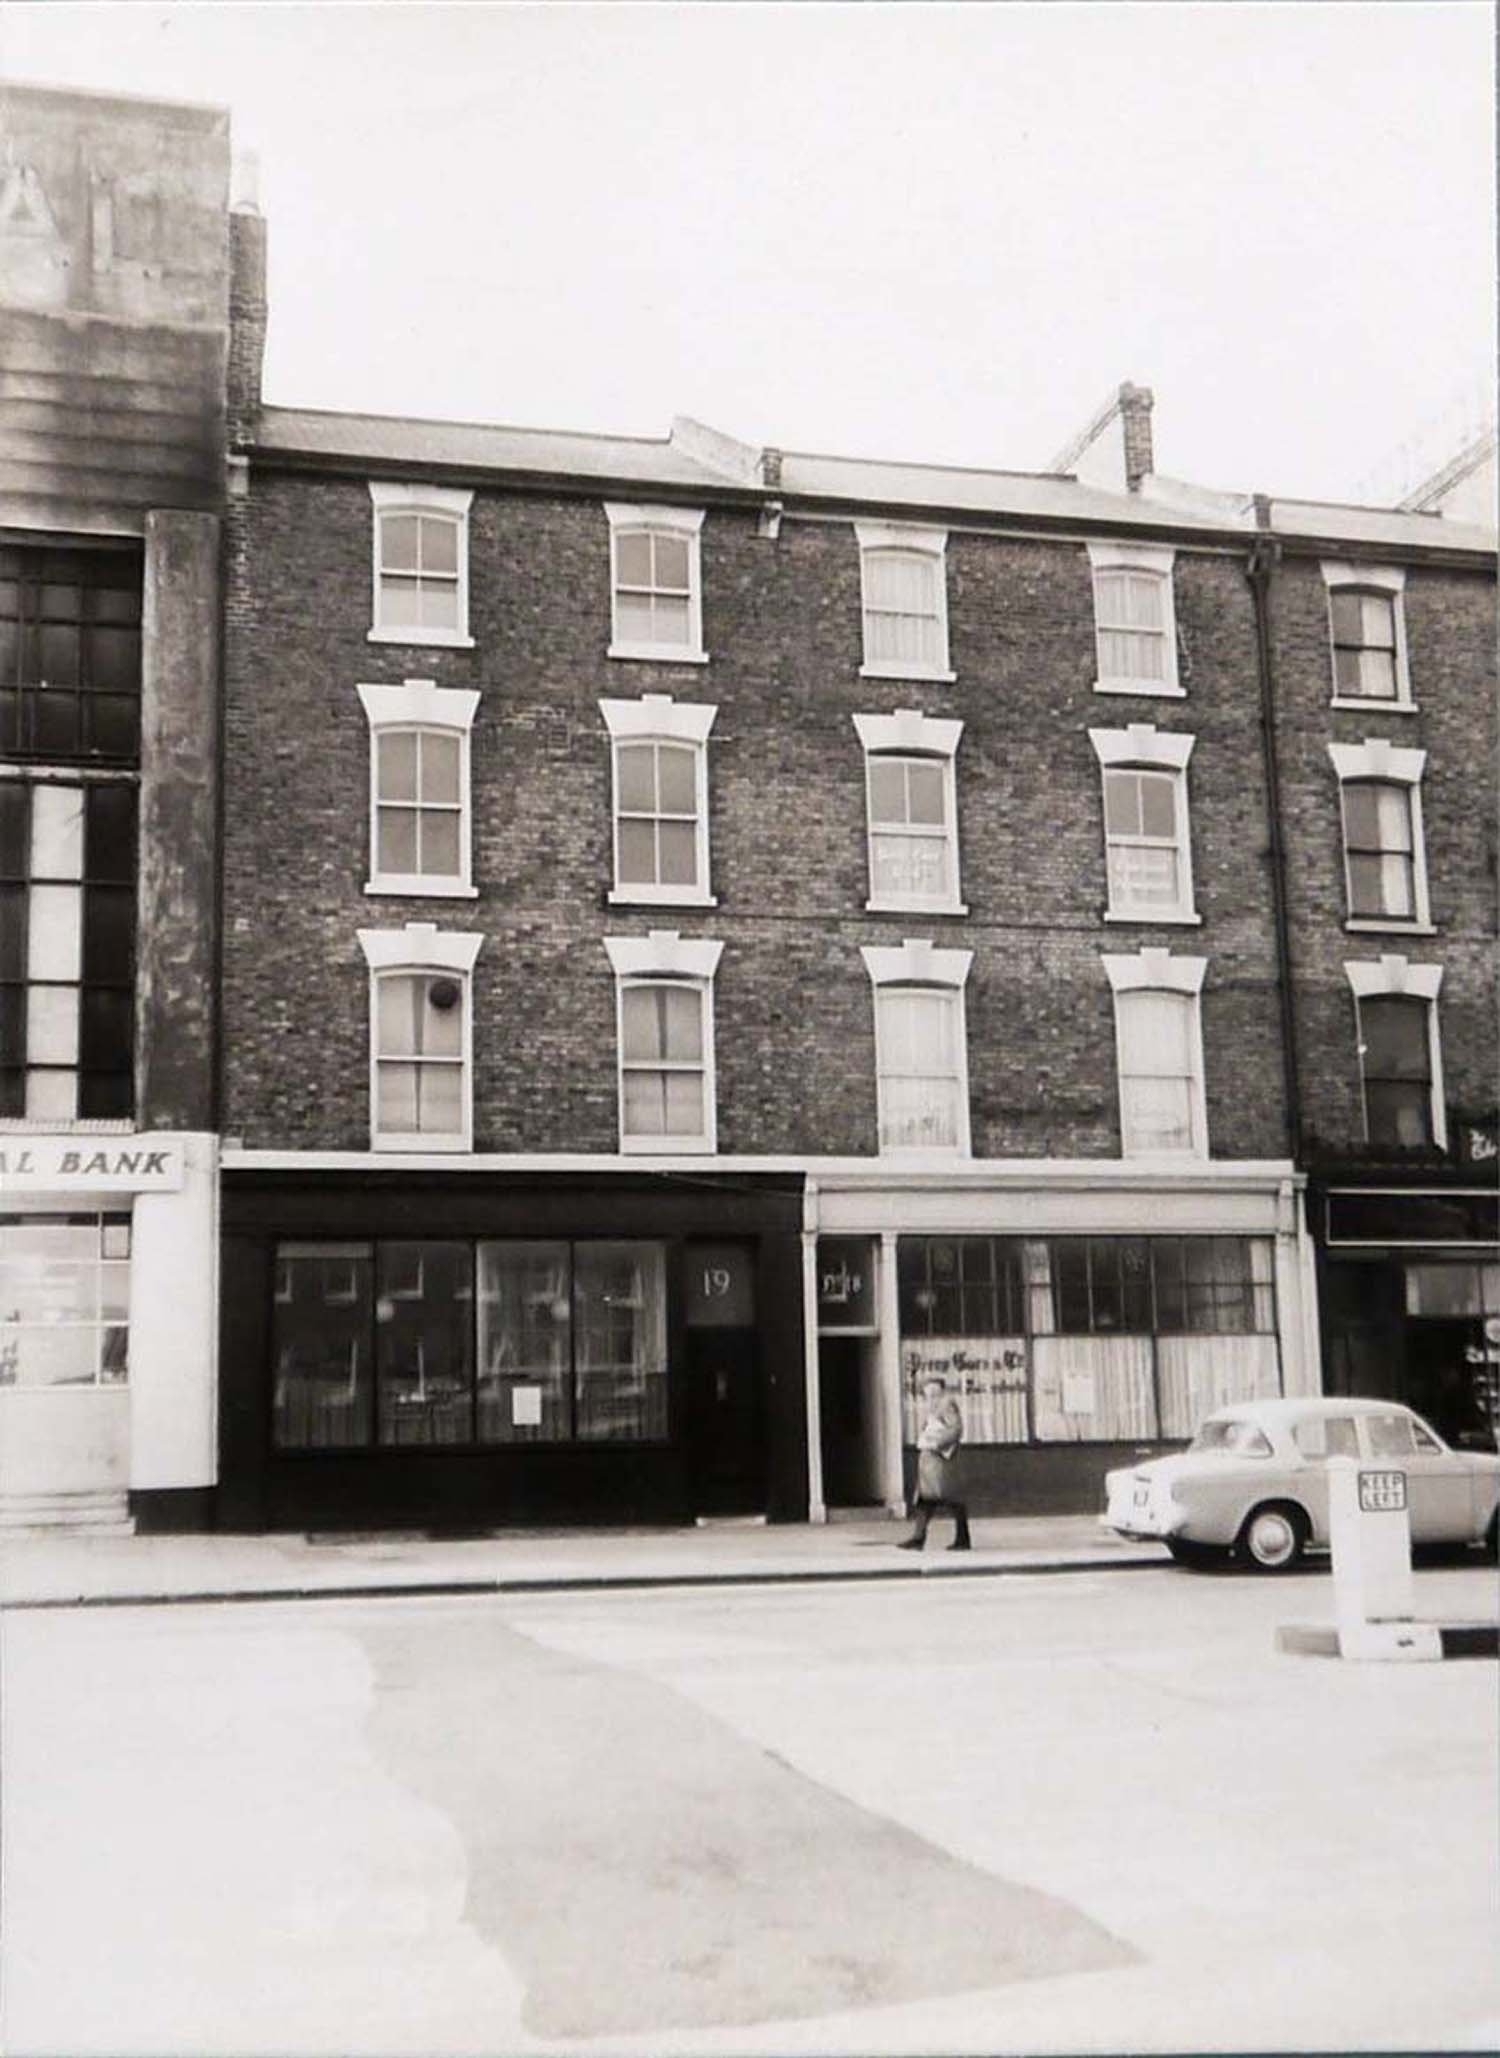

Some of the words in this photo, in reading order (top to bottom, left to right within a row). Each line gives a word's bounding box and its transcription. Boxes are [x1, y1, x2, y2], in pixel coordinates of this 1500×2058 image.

[58, 1152, 171, 1174] BANK
[704, 1269, 730, 1296] 19
[1362, 1475, 1402, 1490] KEEP
[1364, 1492, 1402, 1507] LEFT
